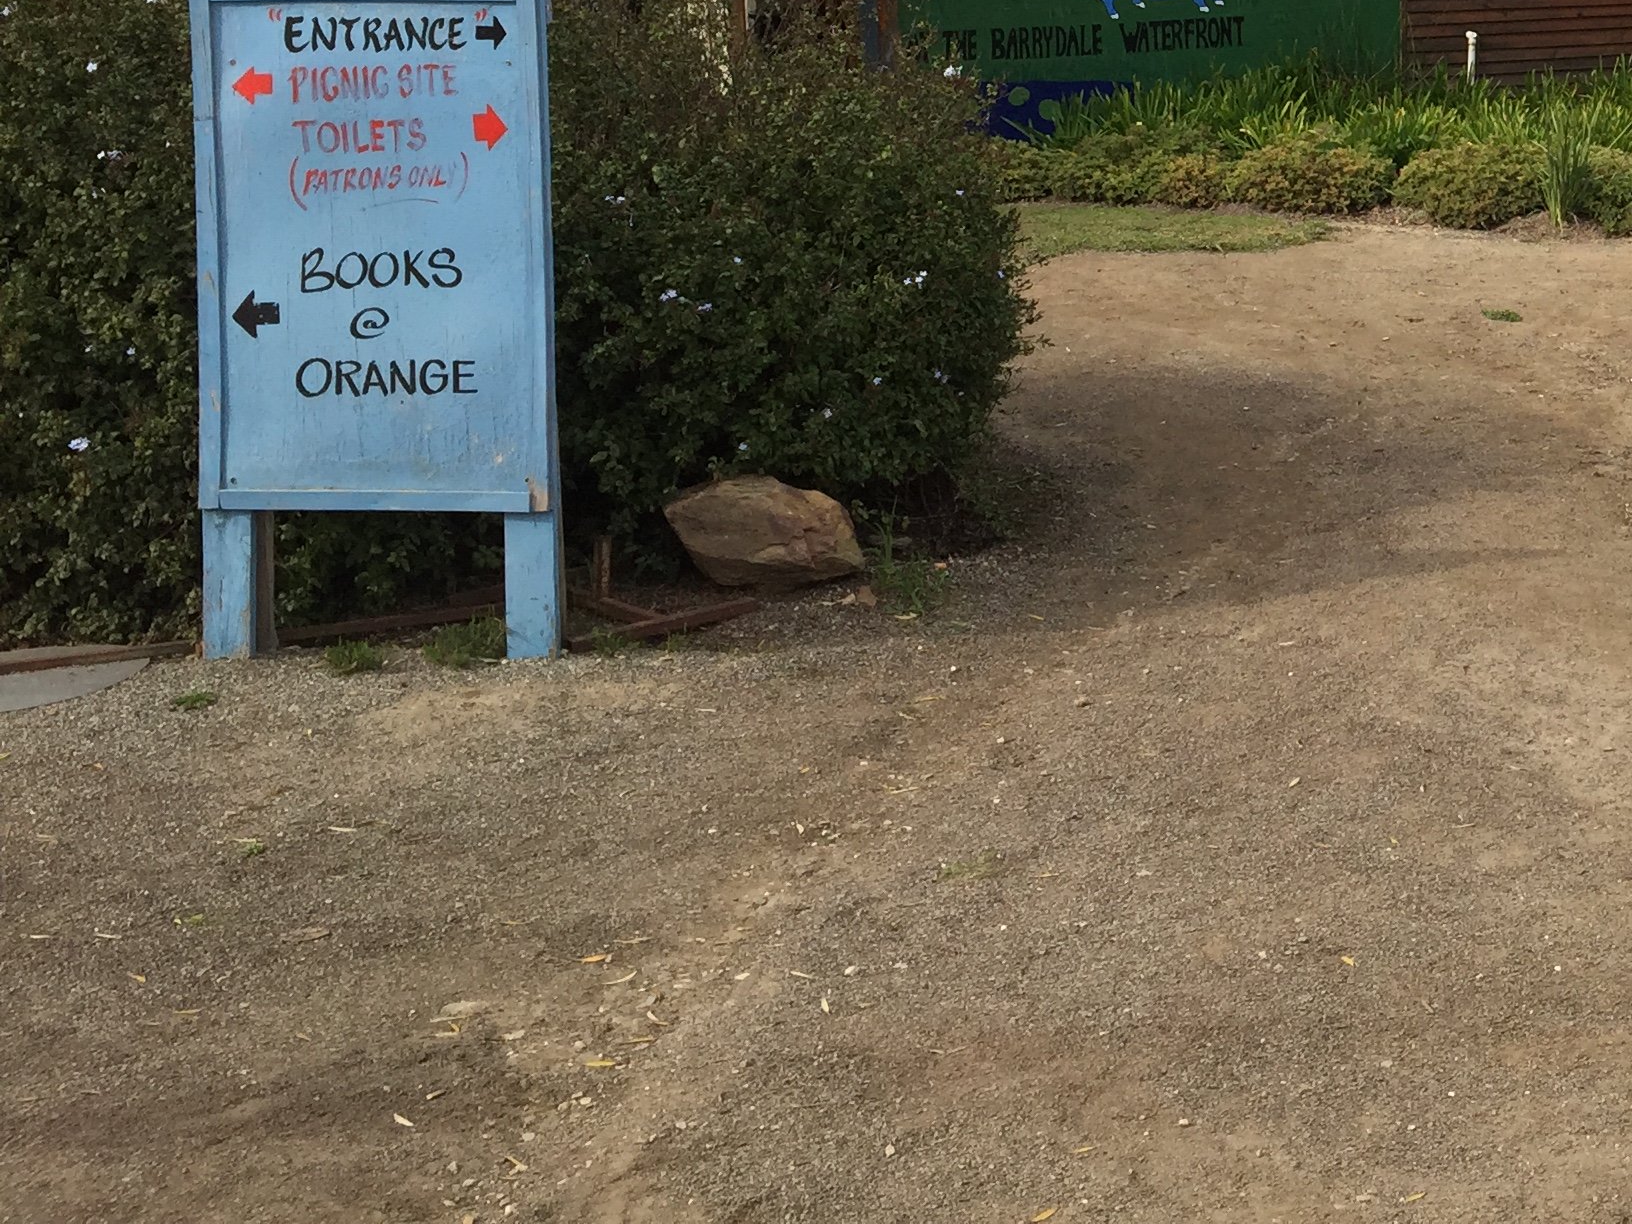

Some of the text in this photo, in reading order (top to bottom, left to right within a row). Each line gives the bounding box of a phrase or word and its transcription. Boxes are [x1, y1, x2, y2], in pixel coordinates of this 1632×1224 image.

[990, 24, 1103, 61] BARRYDALE
[1119, 16, 1245, 53] WATERFRONT
[288, 63, 460, 104] PICNIC SITE
[292, 117, 428, 154] TOILETS
[300, 247, 463, 293] BOOKS
[349, 306, 390, 339] @
[295, 357, 479, 398] ORANGE
